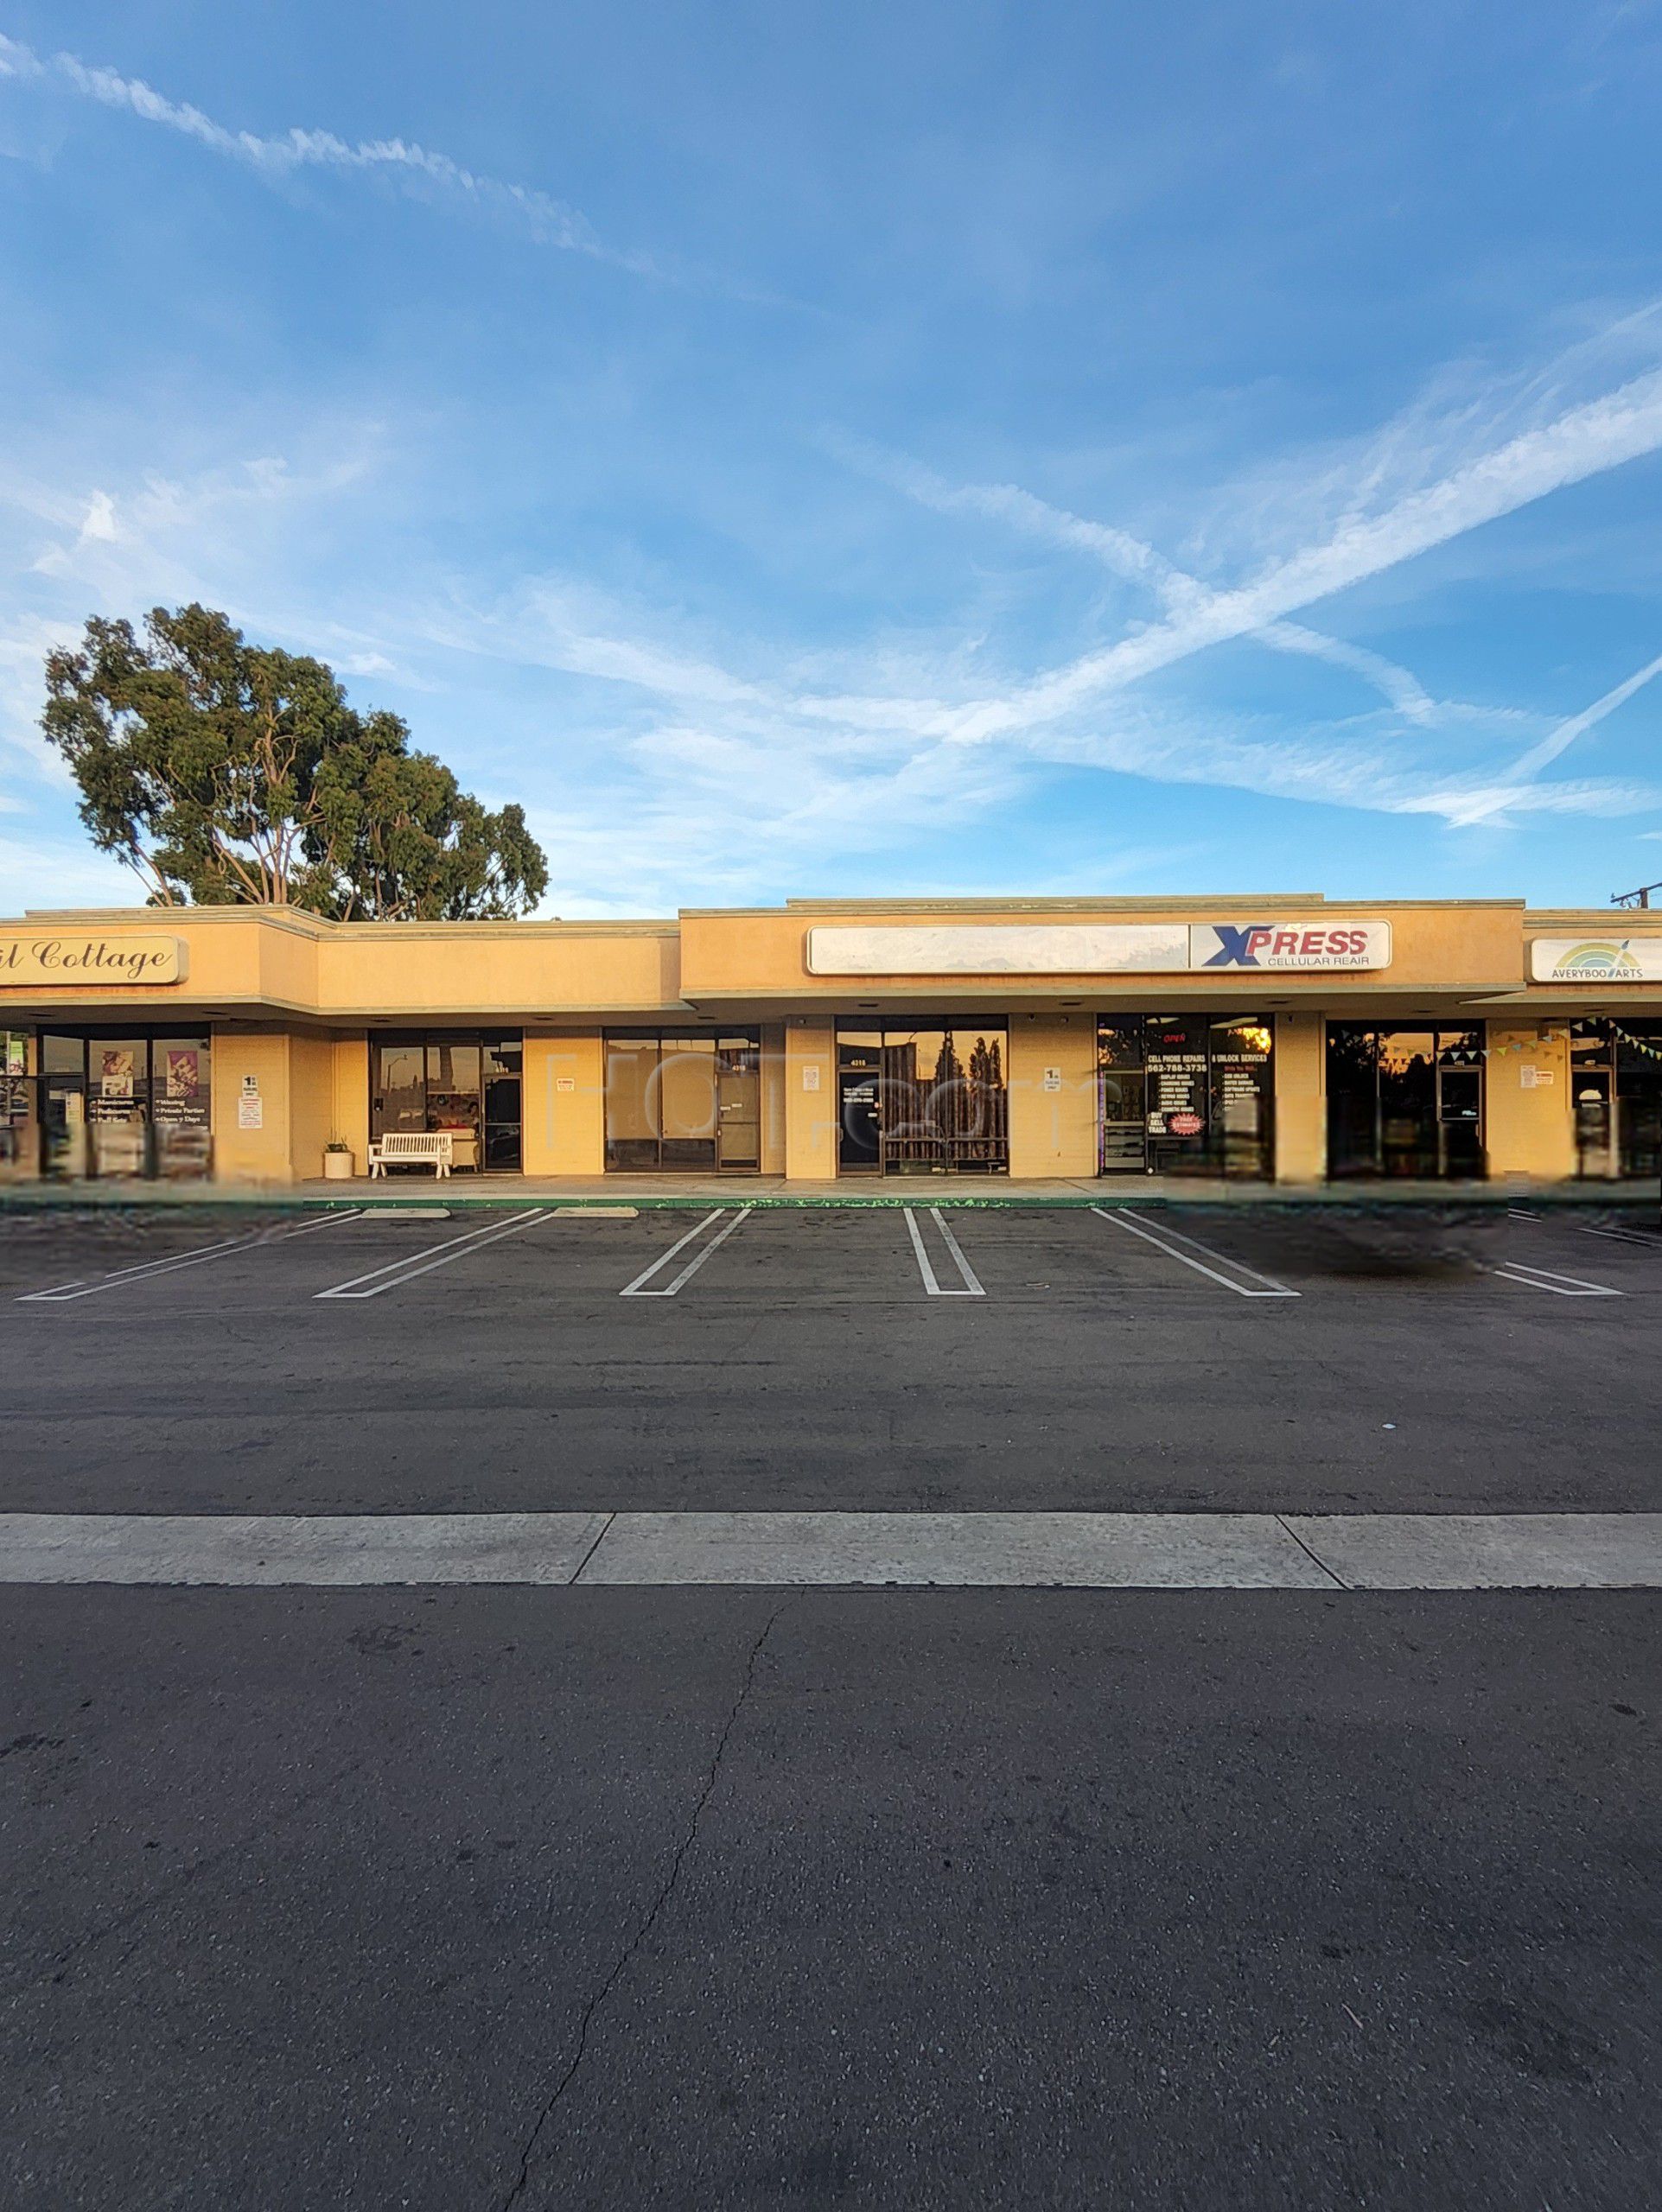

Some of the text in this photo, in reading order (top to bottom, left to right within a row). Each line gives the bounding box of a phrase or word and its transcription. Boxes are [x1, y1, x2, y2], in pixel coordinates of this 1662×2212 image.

[1201, 925, 1369, 967] XPRESS
[31, 941, 174, 979] Cottage
[1268, 957, 1369, 966] CELLULAR REAIR
[1551, 969, 1643, 978] AVERYBOO ARTS
[1163, 1033, 1186, 1043] OPEN
[1217, 1054, 1239, 1063] UNLOCK
[1240, 1054, 1267, 1063] SERVICES
[245, 1077, 251, 1085] 1
